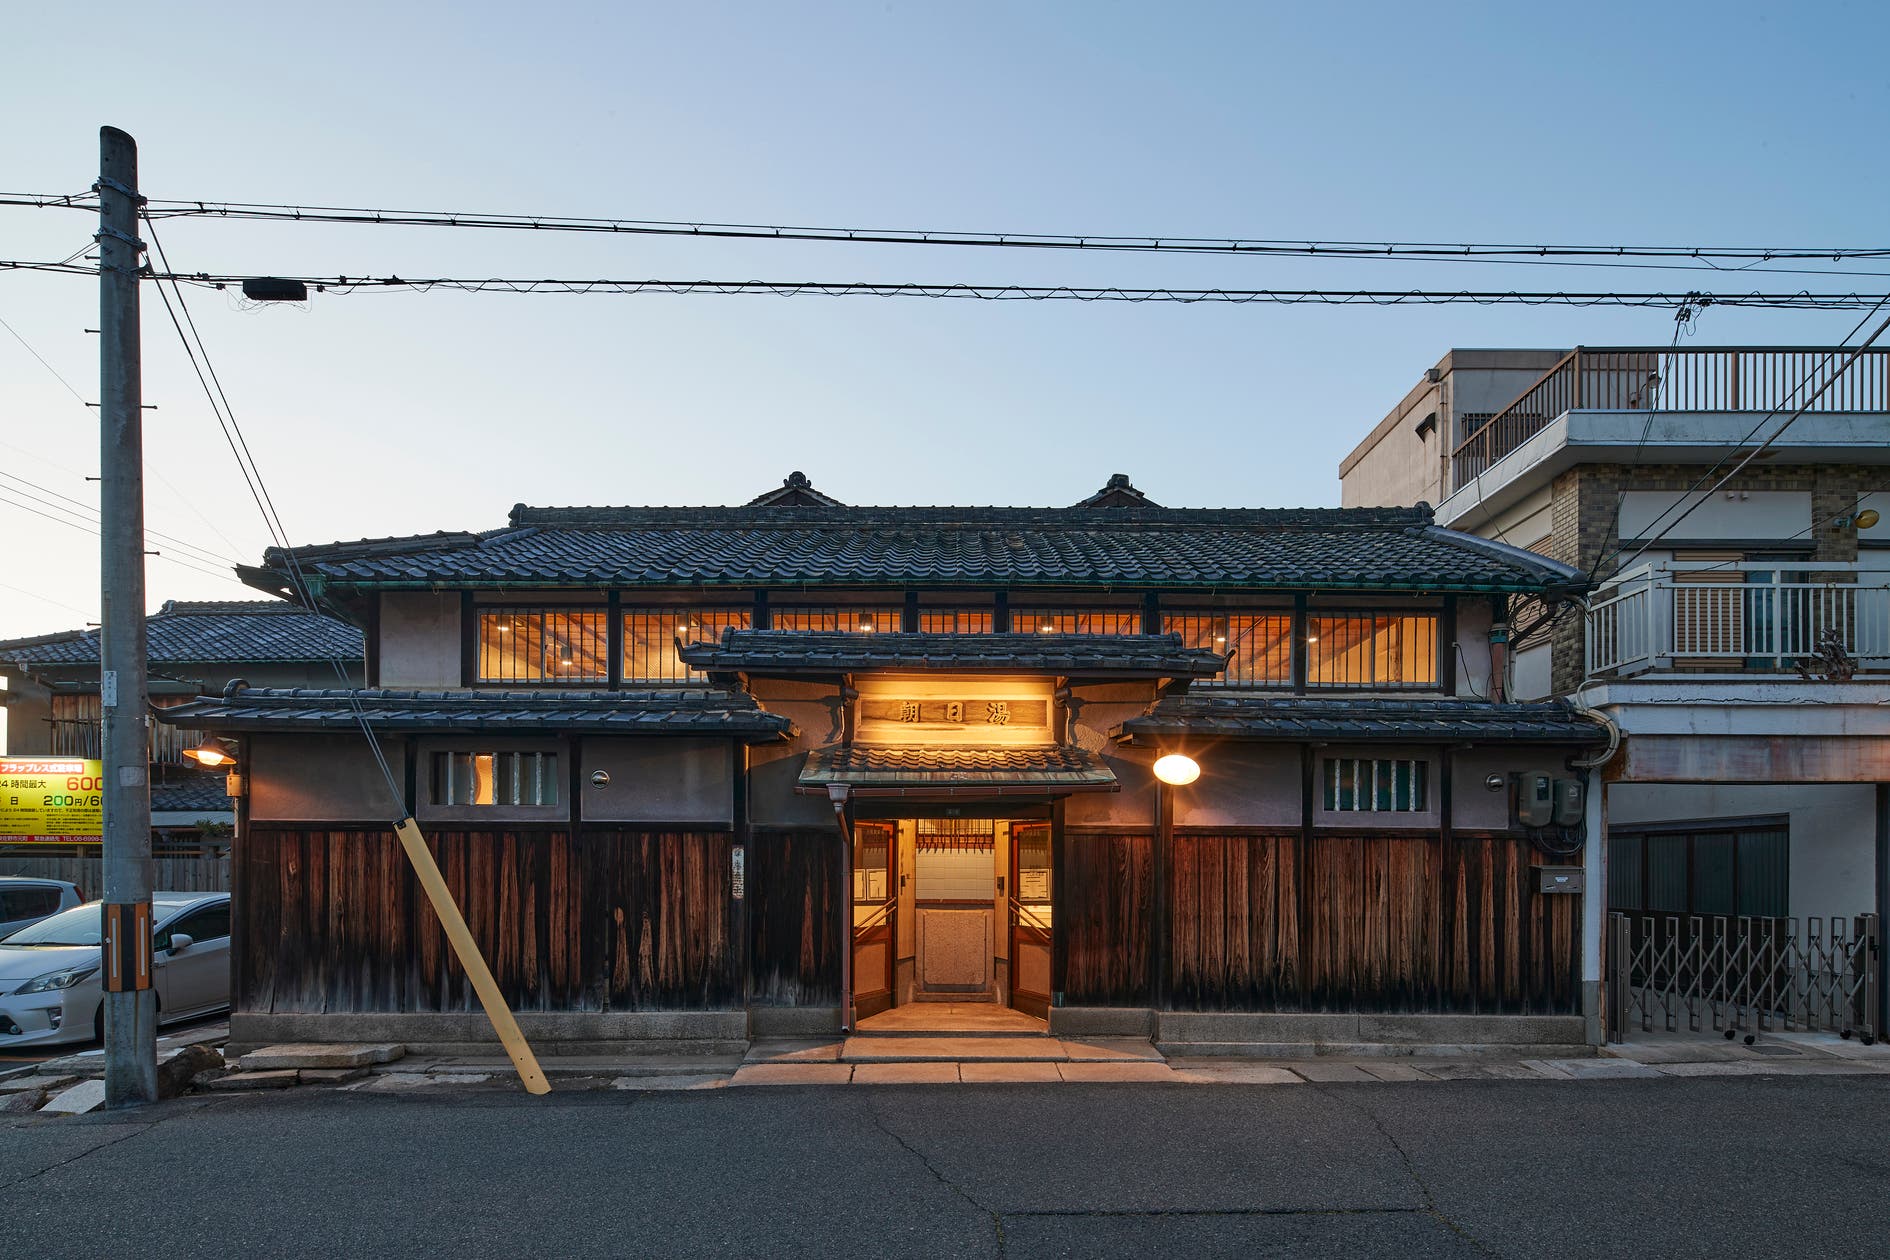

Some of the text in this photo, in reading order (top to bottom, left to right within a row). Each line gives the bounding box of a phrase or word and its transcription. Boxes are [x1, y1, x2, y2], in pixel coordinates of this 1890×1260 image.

[899, 700, 1011, 725] 朝日湯
[43, 795, 103, 806] 200円/6
